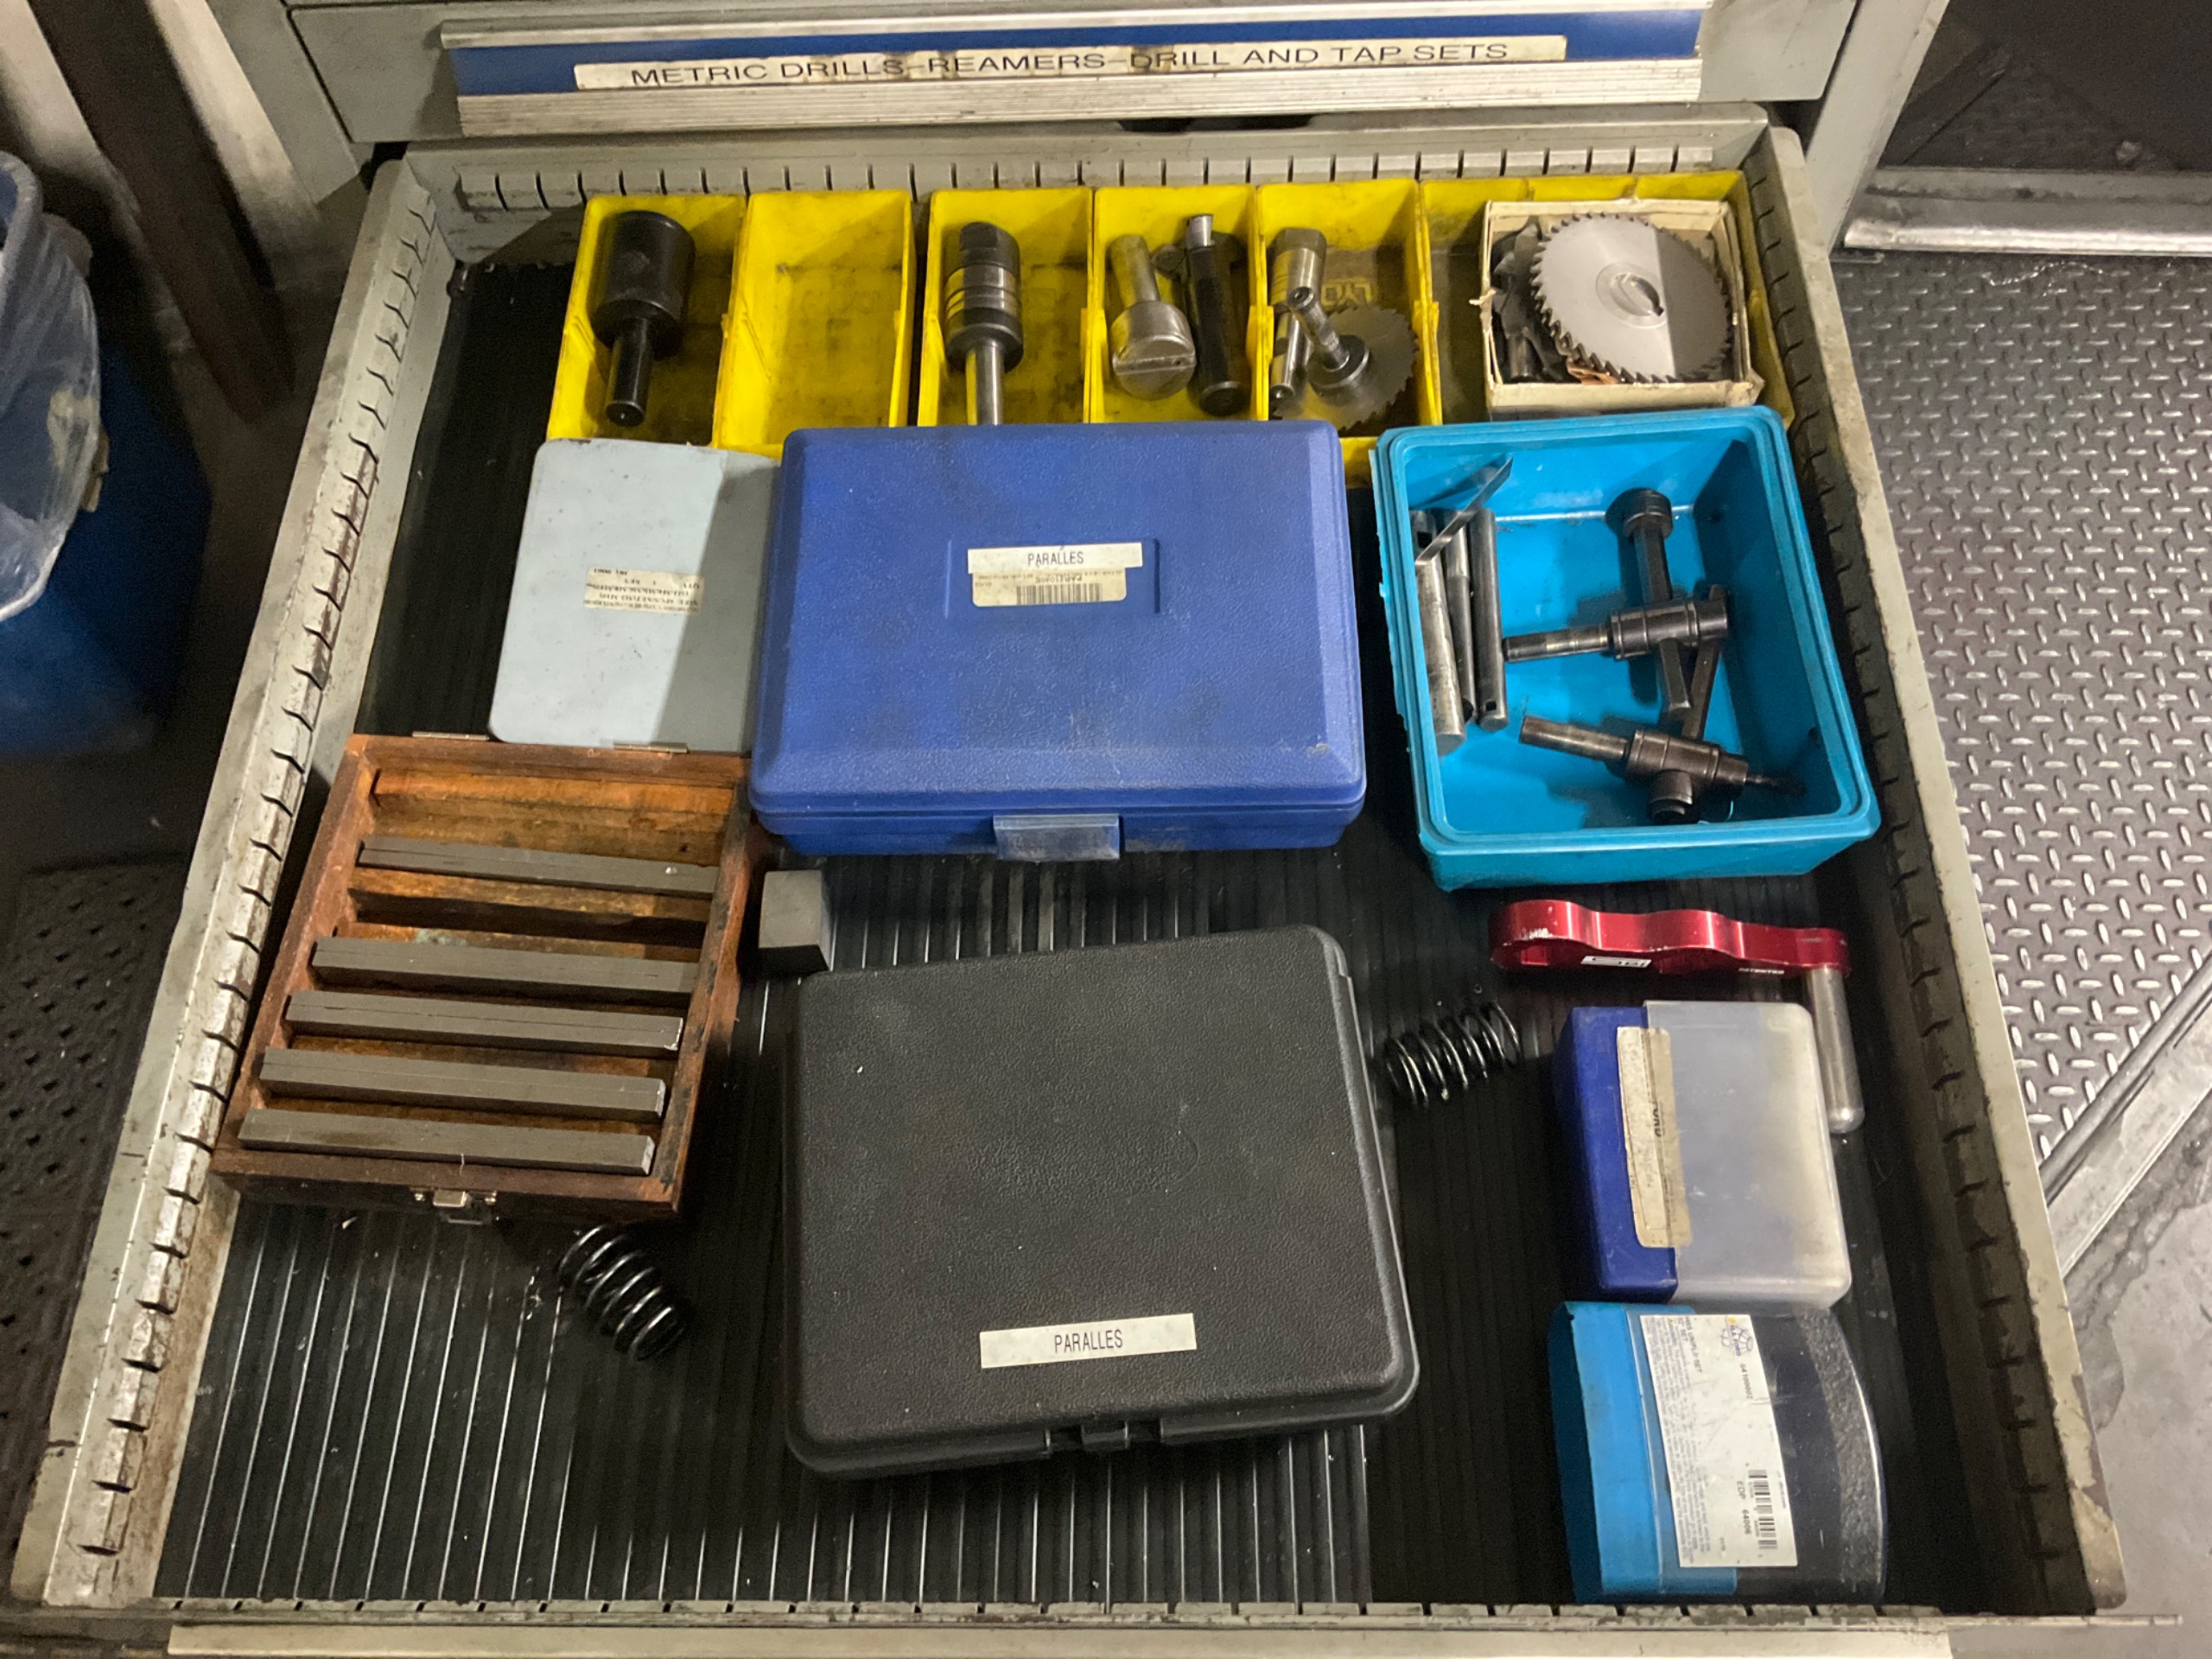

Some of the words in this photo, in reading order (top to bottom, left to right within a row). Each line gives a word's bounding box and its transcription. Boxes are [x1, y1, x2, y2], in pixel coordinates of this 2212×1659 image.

[631, 65, 768, 85] METRIC
[1242, 48, 1319, 65] AND
[1331, 46, 1402, 63] TAP
[1413, 43, 1509, 61] SETS
[1027, 551, 1084, 566] PARALLES
[1054, 1329, 1123, 1354] PARALLES
[1694, 1359, 1702, 1372] SET
[1737, 1480, 1746, 1499] EDP
